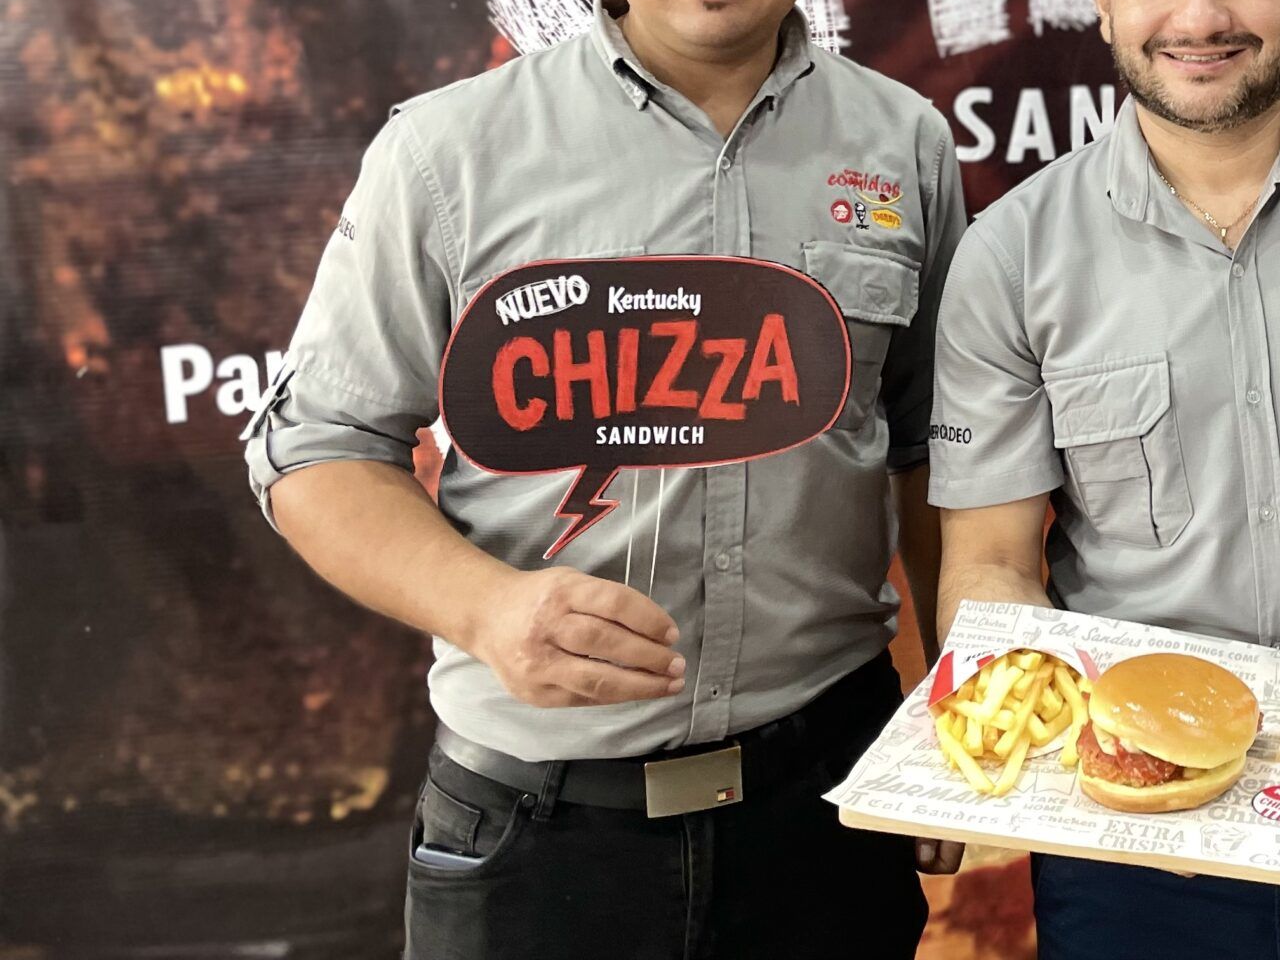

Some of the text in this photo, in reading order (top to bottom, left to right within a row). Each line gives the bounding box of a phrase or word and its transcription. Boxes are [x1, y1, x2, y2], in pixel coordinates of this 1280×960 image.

[495, 274, 589, 326] NUEVO
[608, 286, 702, 316] Kentucky
[595, 426, 705, 445] SANDWICH
[1147, 637, 1181, 650] GOOD
[1183, 642, 1225, 659] THINGS
[1227, 651, 1260, 664] COME
[1097, 833, 1185, 854] CRISPY
[1103, 819, 1187, 843] EXTRA
